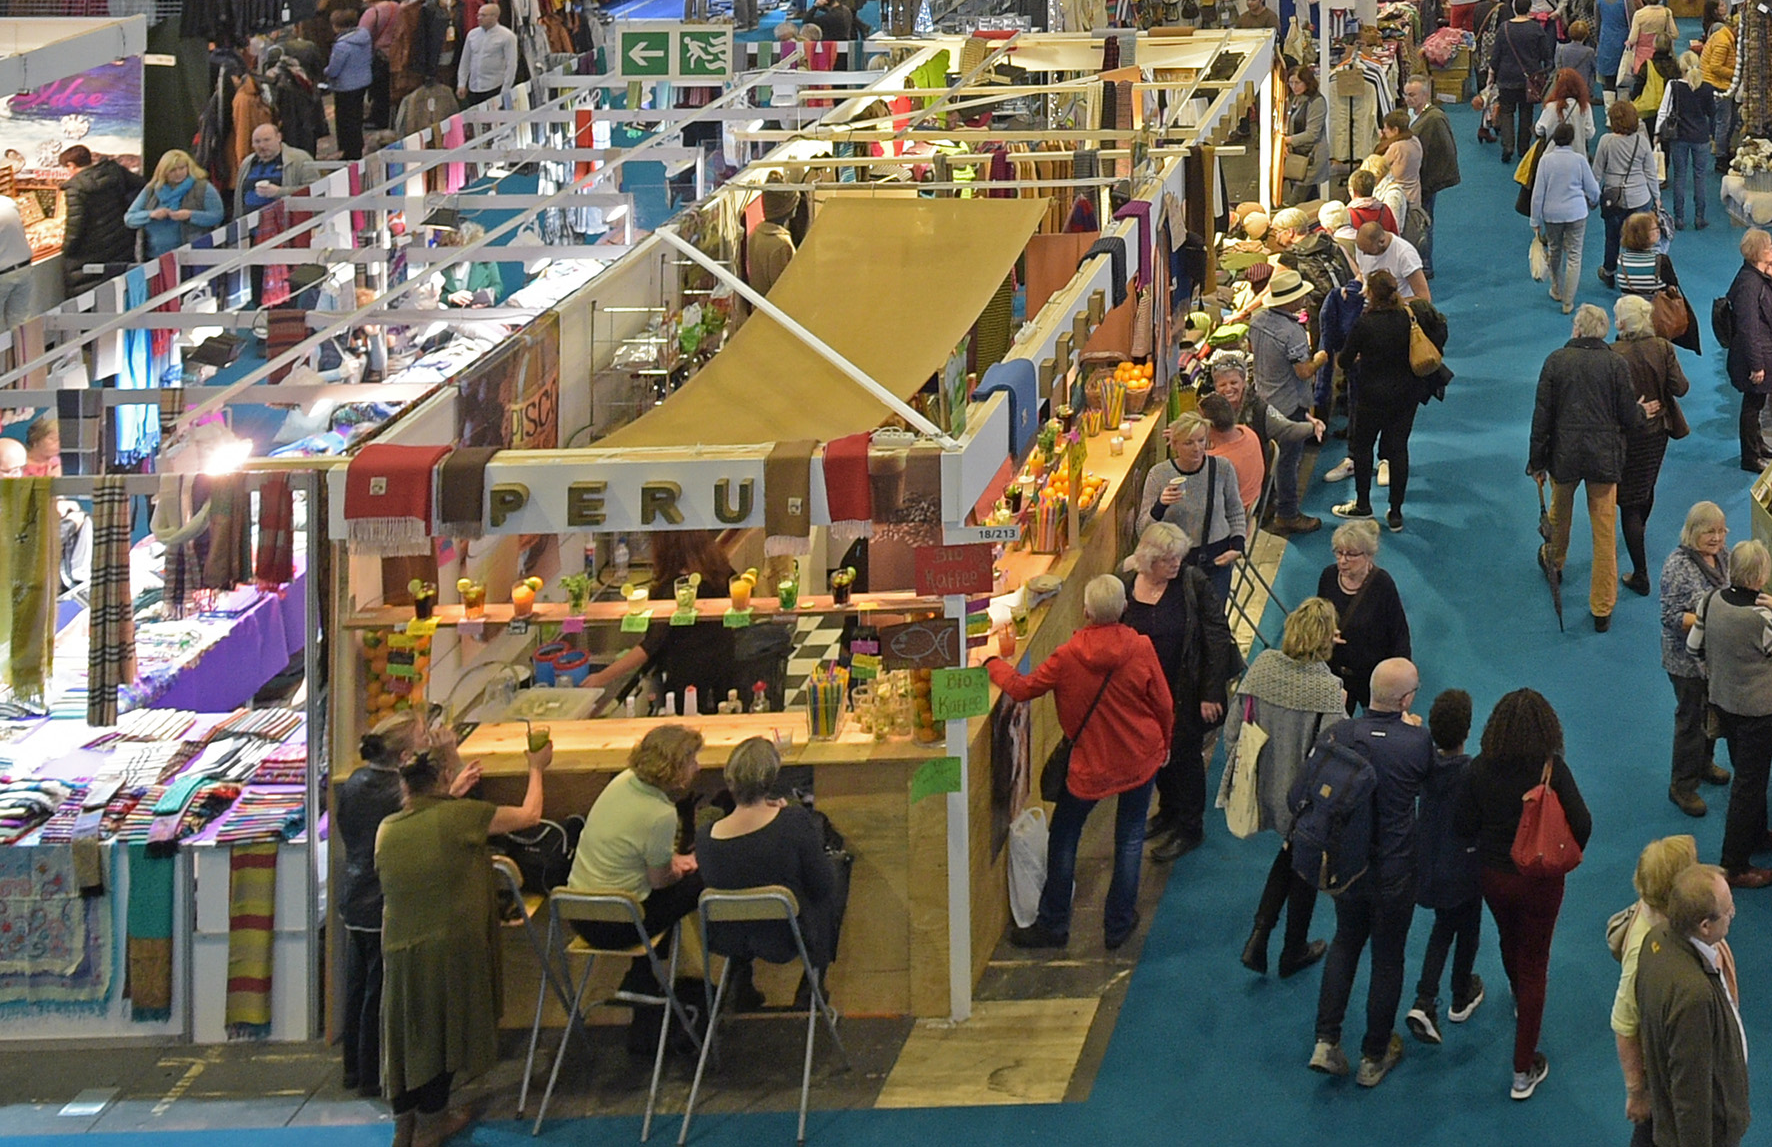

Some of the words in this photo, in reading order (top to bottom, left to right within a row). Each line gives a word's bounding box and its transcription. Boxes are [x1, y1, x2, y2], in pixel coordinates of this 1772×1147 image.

[489, 477, 755, 528] PERU
[979, 529, 1016, 539] 18/213
[945, 674, 972, 689] Bio
